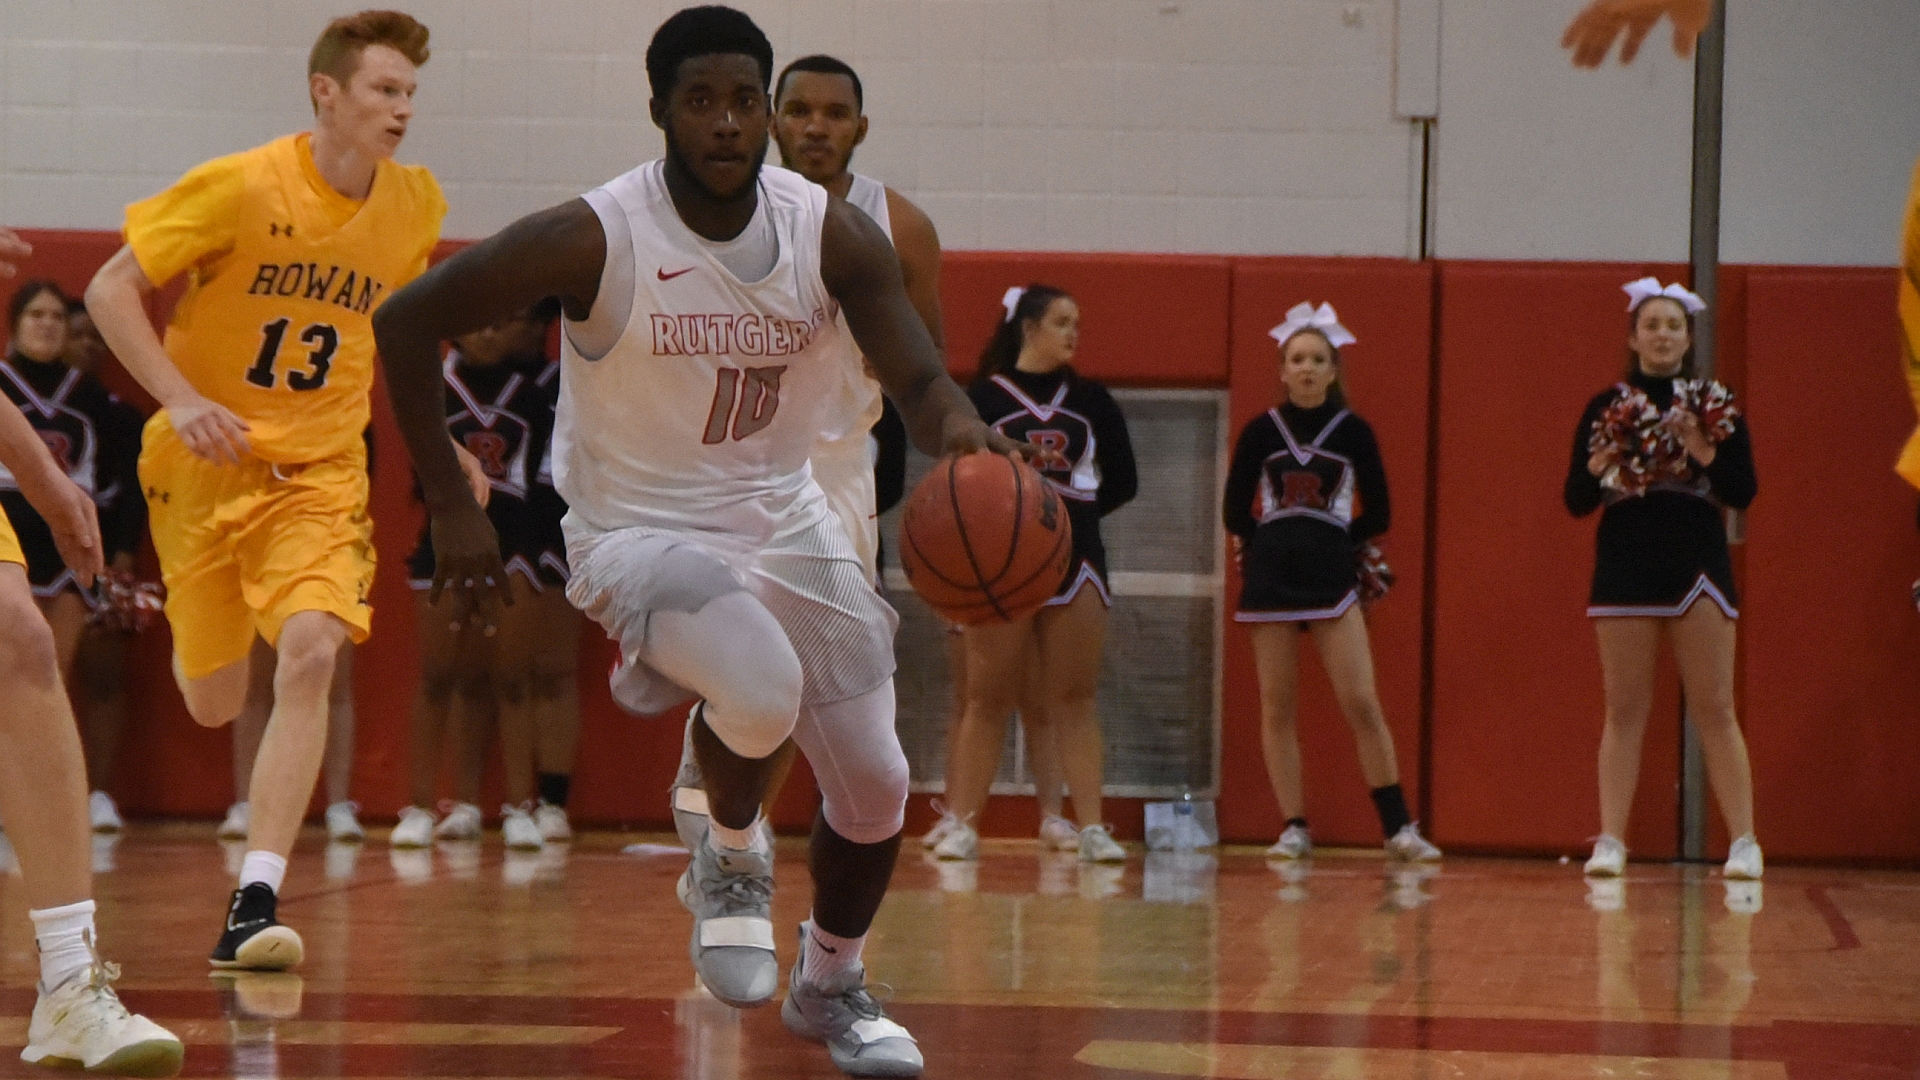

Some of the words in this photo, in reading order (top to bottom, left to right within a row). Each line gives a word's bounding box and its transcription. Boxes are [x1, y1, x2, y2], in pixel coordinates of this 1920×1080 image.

[248, 262, 383, 315] ROWAN
[245, 315, 341, 392] 13
[701, 364, 788, 445] 10
[1025, 429, 1071, 471] R
[1280, 471, 1328, 508] R
